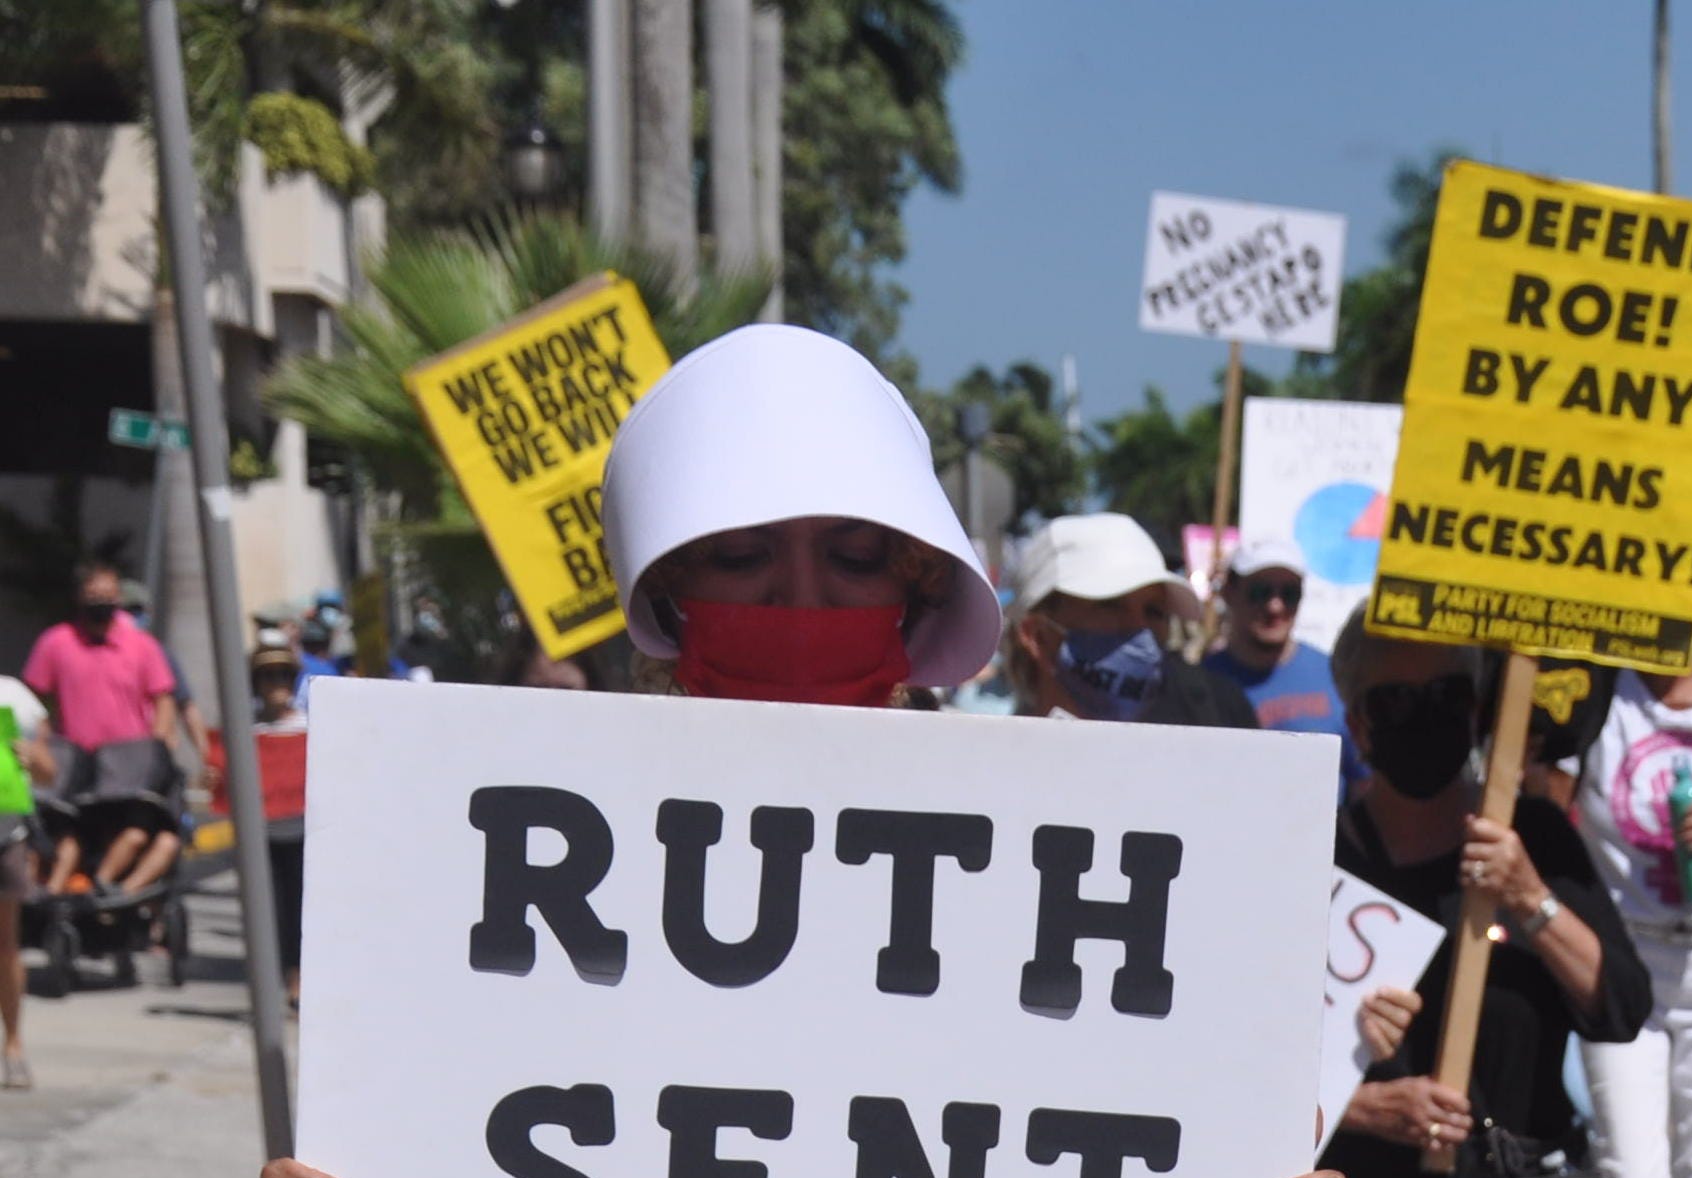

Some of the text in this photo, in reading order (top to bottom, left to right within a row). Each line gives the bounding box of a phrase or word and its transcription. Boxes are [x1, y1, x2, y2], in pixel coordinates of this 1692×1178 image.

[1159, 211, 1212, 255] NO
[1506, 273, 1679, 348] ROE!
[443, 307, 628, 416] WE WON'T
[1463, 348, 1550, 403] BY
[475, 349, 638, 449] GO BACK
[493, 431, 560, 487] WE
[1461, 440, 1664, 511] MEANS
[1428, 611, 1596, 652] AND LIBERATION
[1432, 583, 1503, 614] PARTY
[1506, 596, 1548, 621] FOR
[1549, 601, 1660, 640] SOCIALISM
[468, 786, 1183, 1016] RUTH
